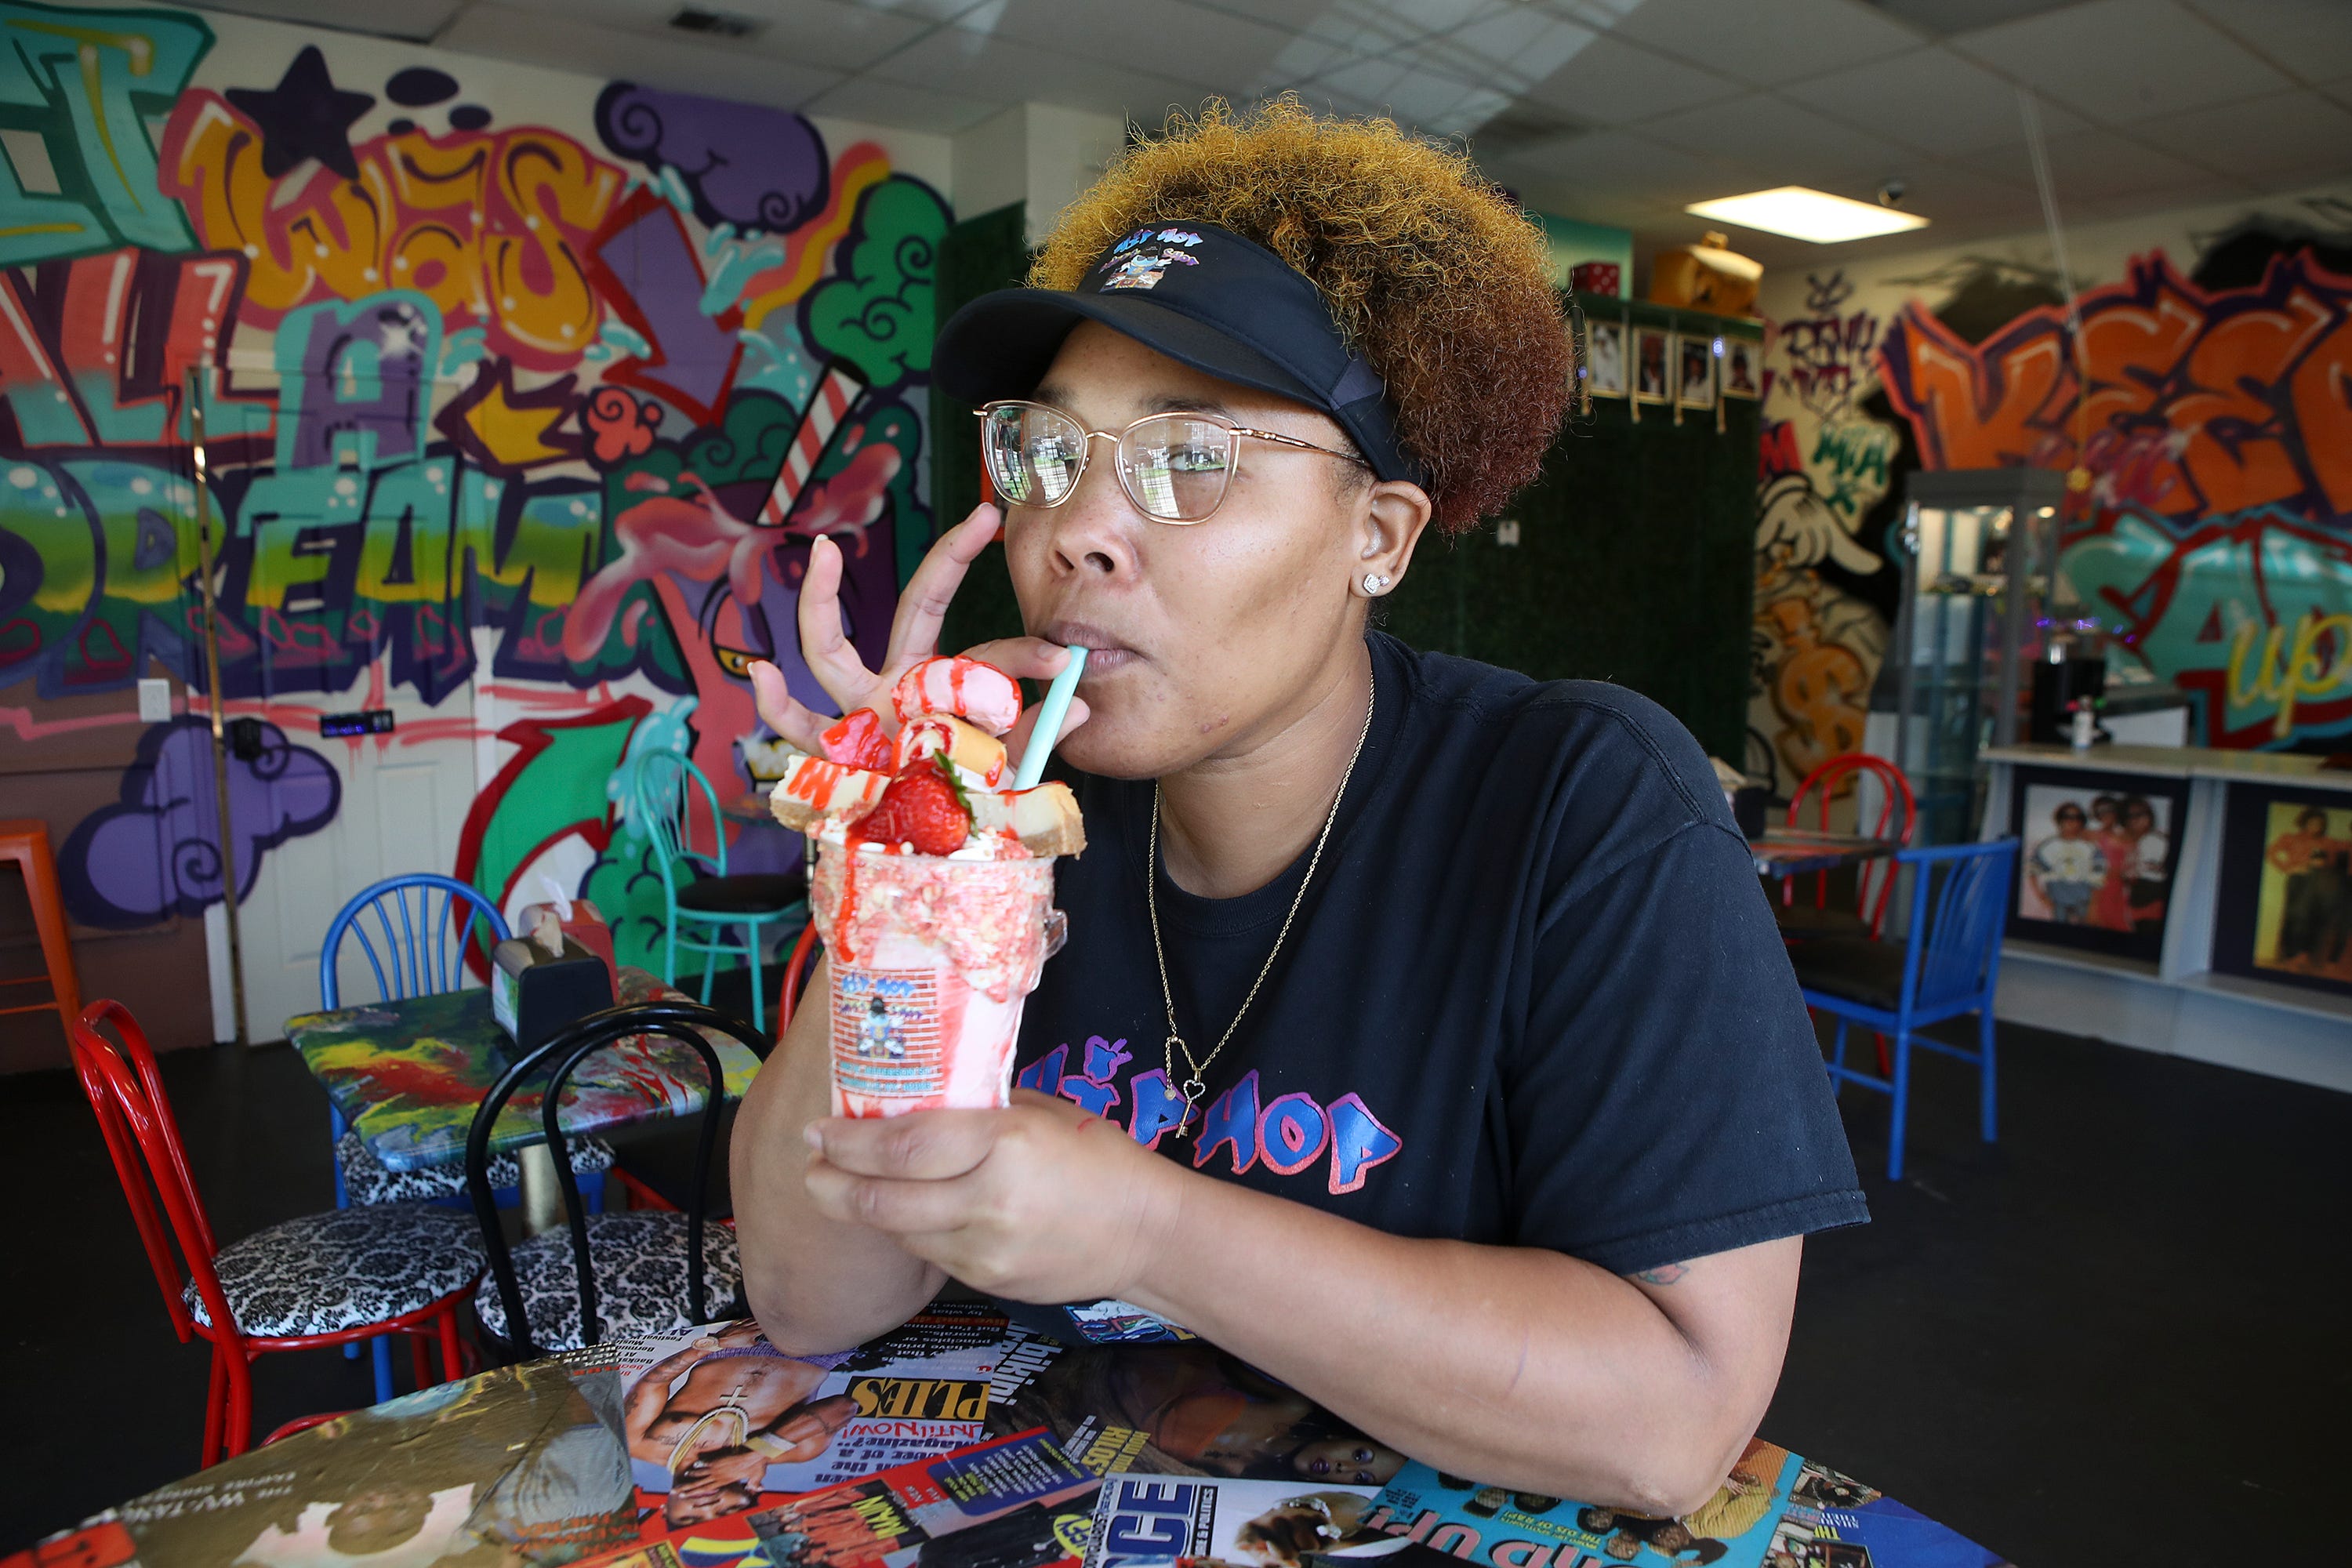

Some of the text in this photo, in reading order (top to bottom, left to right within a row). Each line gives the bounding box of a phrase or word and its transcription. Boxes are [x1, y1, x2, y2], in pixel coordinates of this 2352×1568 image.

[1156, 228, 1203, 247] HOP
[1162, 248, 1200, 266] SHOP
[1192, 1068, 1403, 1196] HOP
[922, 1336, 991, 1345] principles
[988, 1342, 1063, 1406] bikini
[850, 1377, 990, 1421] PLIES
[839, 1449, 855, 1459] a
[832, 1461, 868, 1472] the
[1197, 1487, 1214, 1530] POLITICS
[1534, 1520, 1554, 1531] OF
[1580, 1532, 1601, 1544] THE
